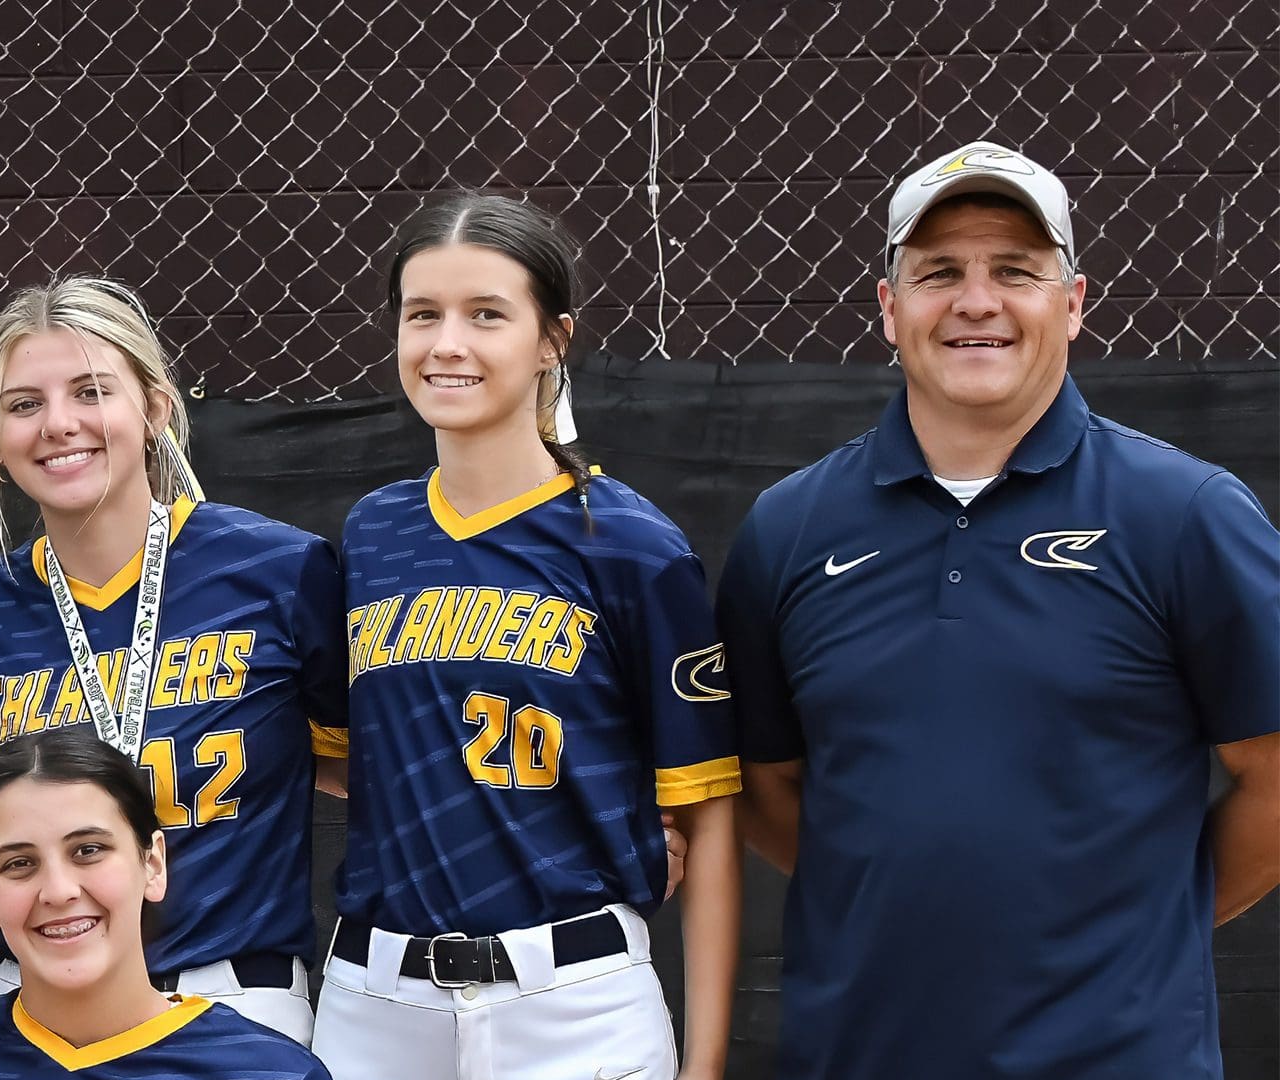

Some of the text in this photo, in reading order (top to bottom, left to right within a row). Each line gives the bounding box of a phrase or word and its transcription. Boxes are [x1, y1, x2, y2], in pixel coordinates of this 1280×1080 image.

[142, 531, 165, 605] SOFTBALL
[347, 583, 599, 690] GHLANDERS
[123, 669, 147, 746] SOFTBALL
[462, 690, 565, 790] 20
[139, 727, 248, 829] 12
